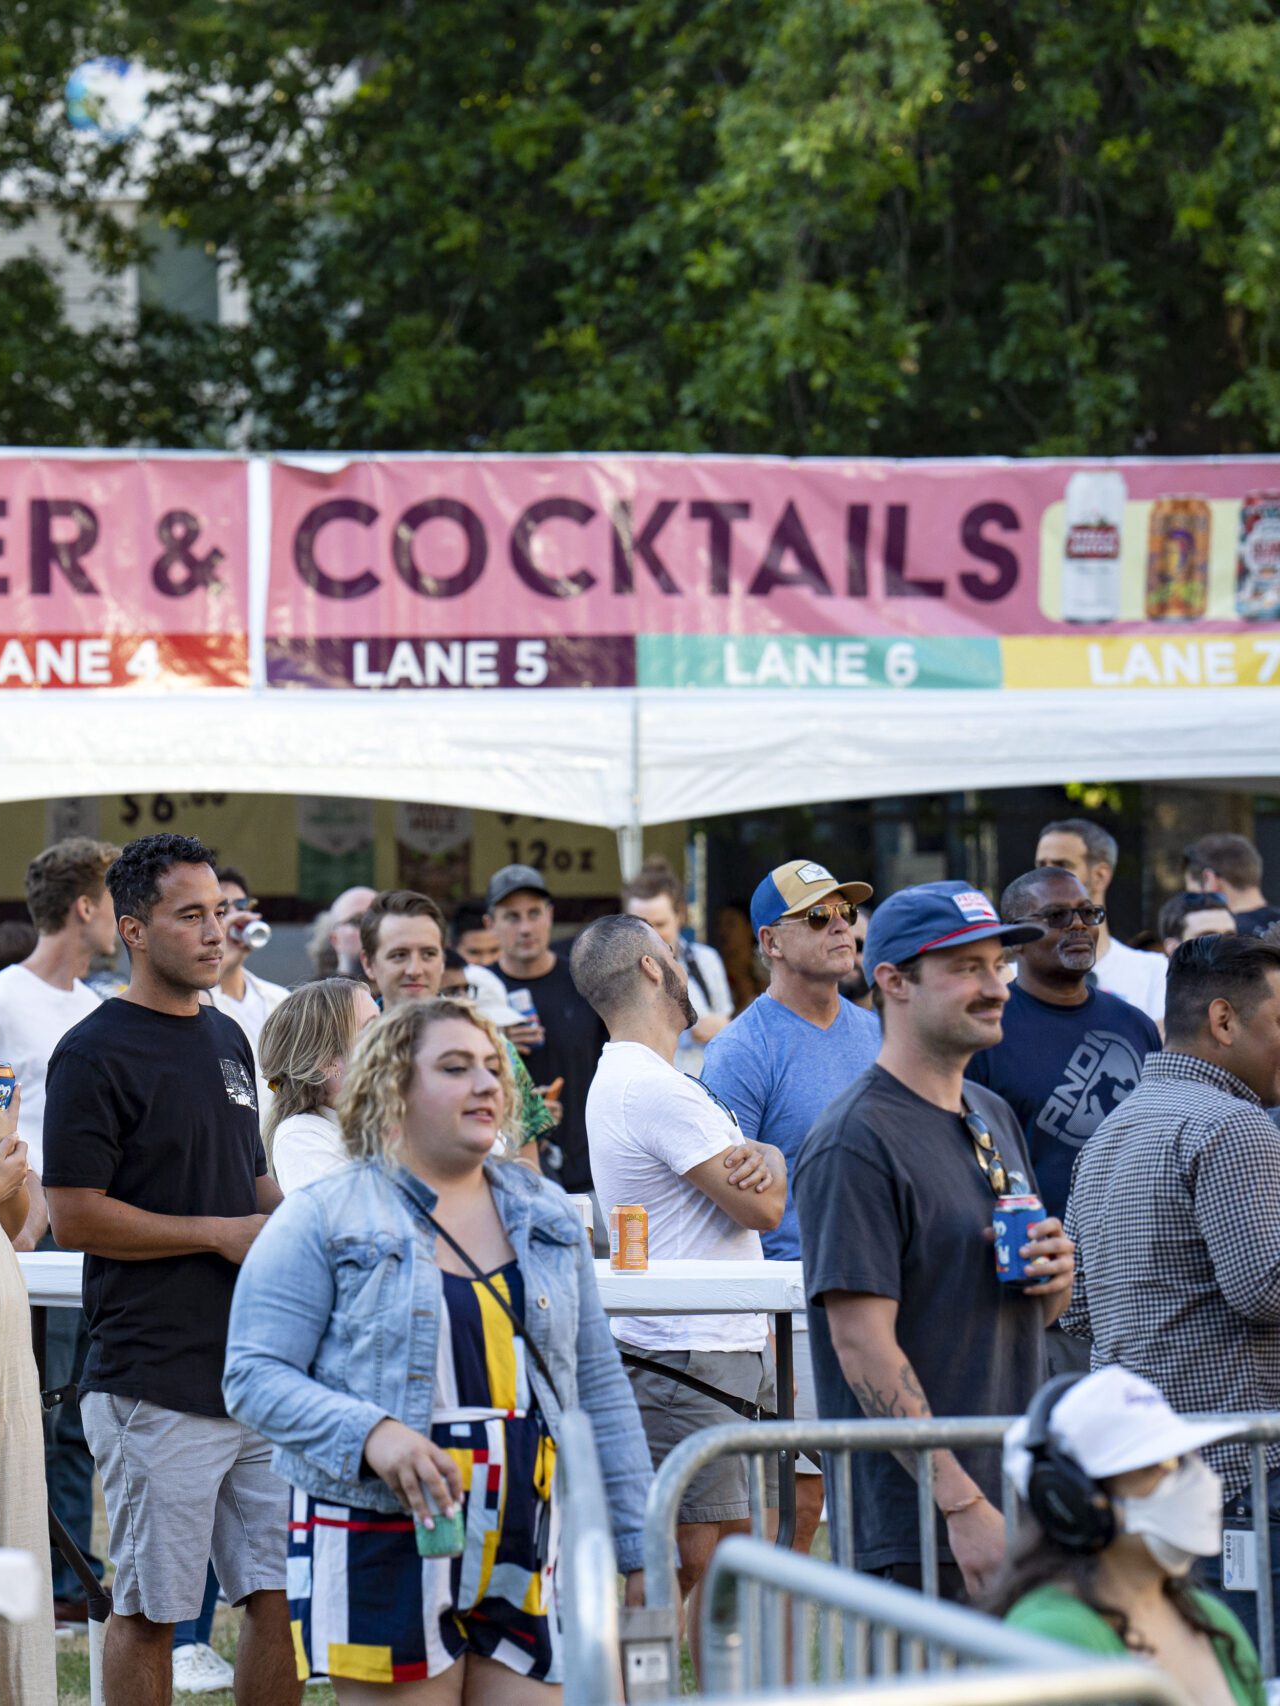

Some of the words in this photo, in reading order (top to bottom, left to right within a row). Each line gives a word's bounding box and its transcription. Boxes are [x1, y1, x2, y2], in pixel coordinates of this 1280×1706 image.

[151, 508, 224, 598] &
[292, 496, 1023, 603] COCKTAILS
[125, 639, 160, 682] 4
[352, 640, 500, 686] LANE
[515, 640, 548, 686] 5
[723, 643, 869, 685] LANE
[884, 642, 918, 686] 6
[1087, 642, 1237, 684] LANE
[1252, 642, 1280, 684] 7
